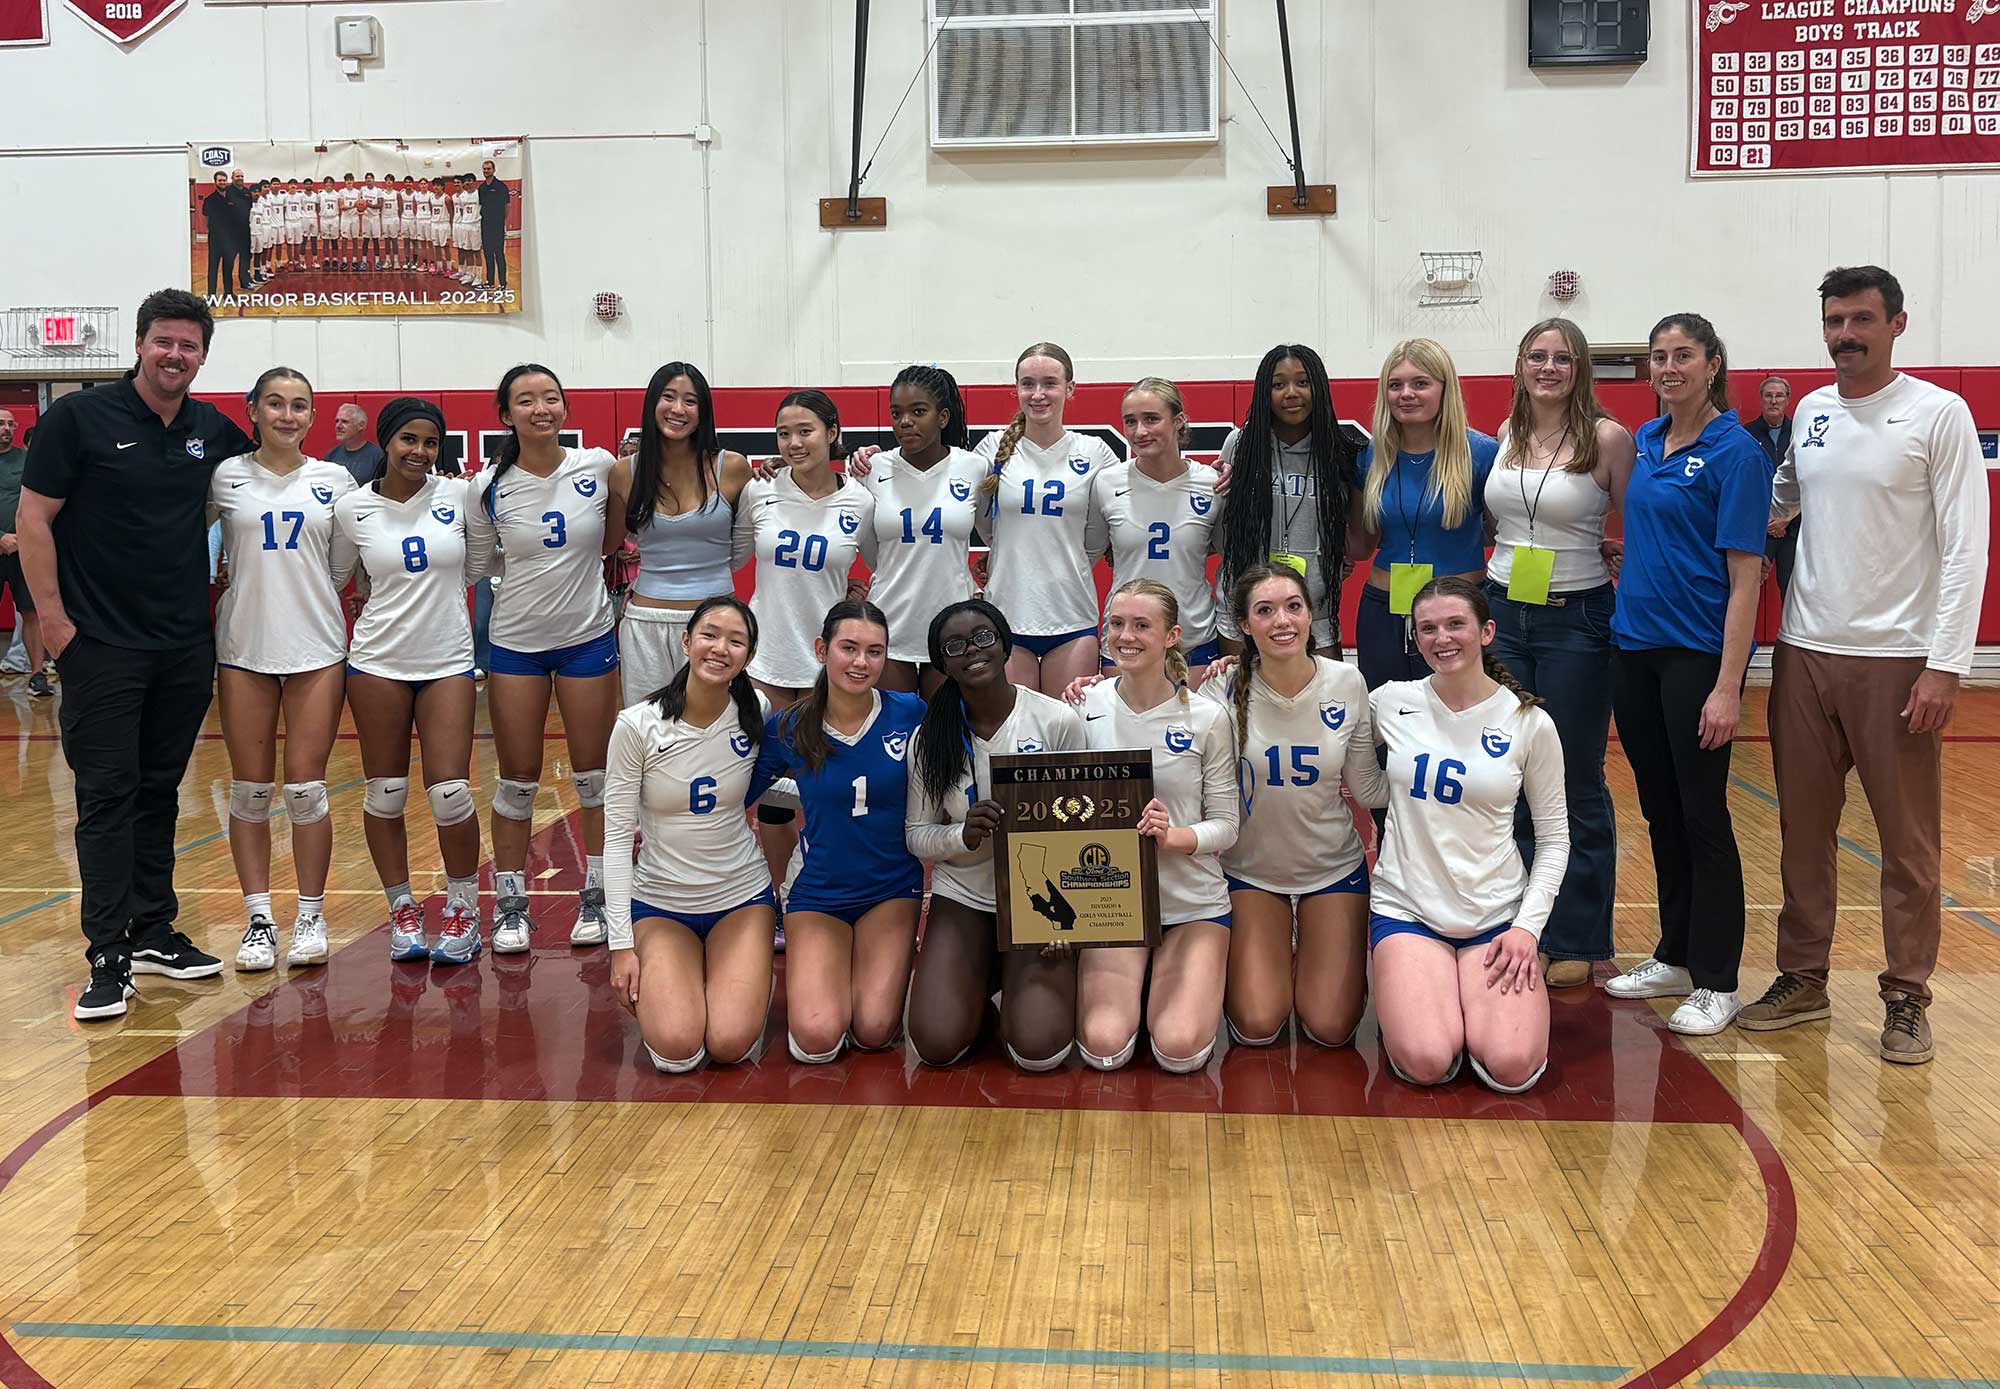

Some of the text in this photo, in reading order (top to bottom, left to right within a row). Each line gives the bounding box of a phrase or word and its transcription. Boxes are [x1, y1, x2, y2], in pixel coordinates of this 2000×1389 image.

[105, 3, 142, 19] 2018
[1761, 0, 1956, 20] LEAGUE CHAMPIONS
[1795, 20, 1920, 43] BOYS TRACK
[1718, 55, 1733, 70] 31
[1748, 55, 1766, 70] 32
[1780, 53, 1799, 69] 33
[1814, 52, 1833, 67] 34
[1846, 50, 1866, 66] 35
[1880, 49, 1899, 64] 36
[1913, 47, 1934, 63] 37
[1947, 48, 1965, 63] 38
[1716, 70, 2000, 93] 50 51 55 62 71 72 74 76 77
[1715, 94, 1998, 116] 78 79 80 82 83 84 85 86 87
[1715, 117, 1997, 139] 89 90 93 94 96 98 99 01 02
[204, 150, 229, 161] COAST
[1714, 147, 1764, 164] 03 21
[202, 289, 516, 308] WARRIOR BASKETBALL 2024-25
[45, 318, 75, 341] EXIT
[1021, 480, 1065, 517] 12
[261, 511, 305, 551] 17
[541, 512, 566, 548] 3
[899, 507, 943, 544] 14
[774, 529, 829, 572] 20
[1148, 522, 1170, 560] 2
[402, 535, 429, 573] 8
[1014, 765, 1131, 782] CHAMPIONS
[1264, 745, 1319, 787] 15
[1410, 753, 1467, 805] 16
[689, 775, 717, 815] 6
[851, 775, 869, 817] 1
[1017, 799, 1131, 821] 20 25
[1061, 880, 1130, 888] CHAMPIONSHIPS
